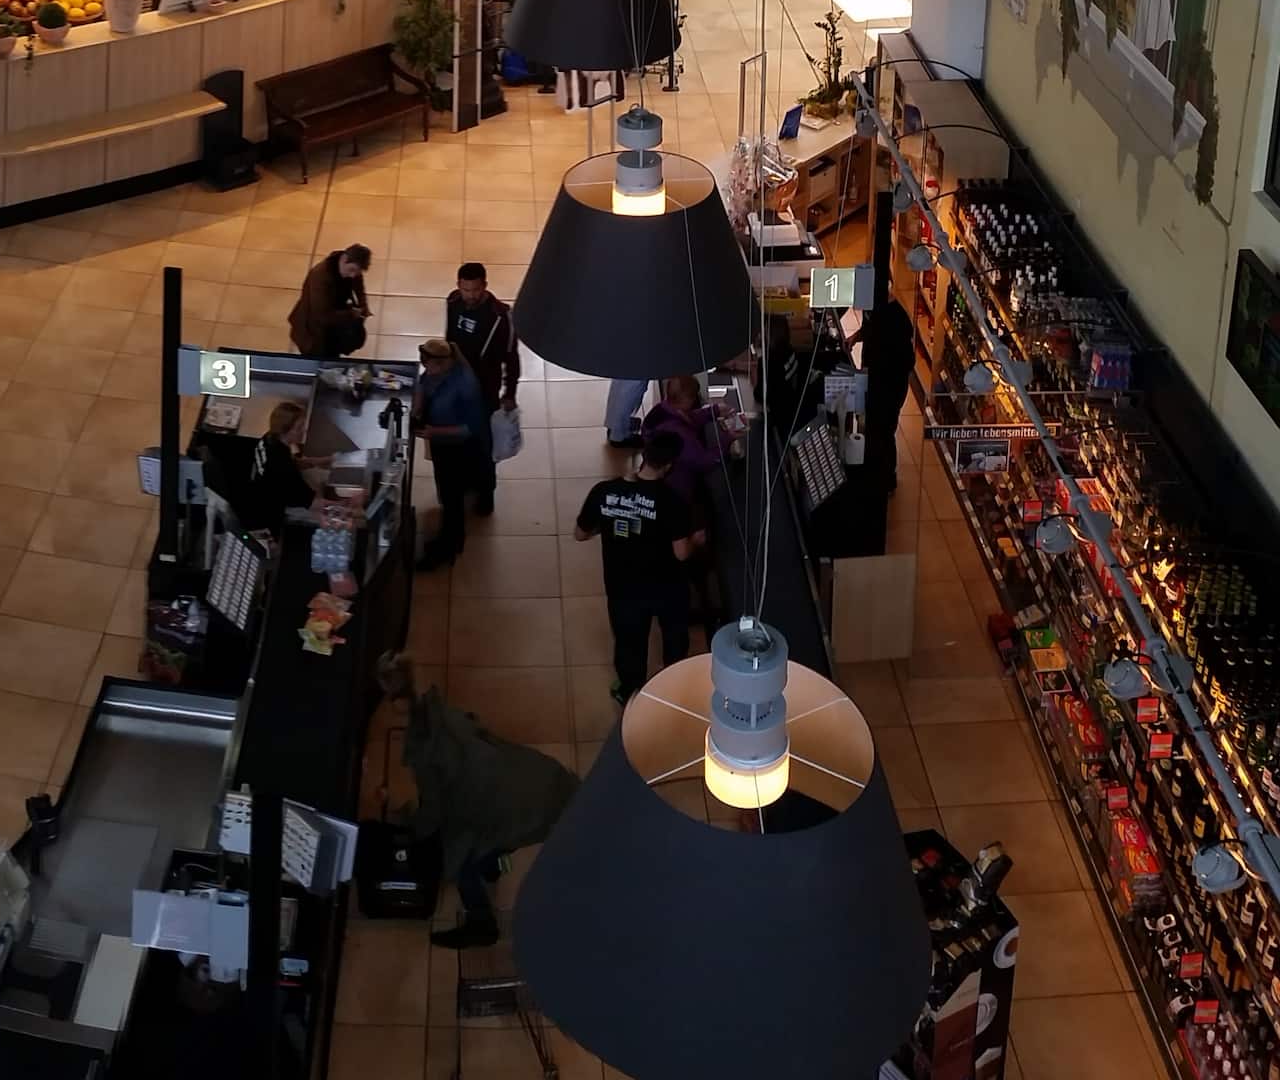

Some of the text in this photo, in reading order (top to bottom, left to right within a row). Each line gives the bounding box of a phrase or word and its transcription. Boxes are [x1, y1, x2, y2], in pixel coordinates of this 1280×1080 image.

[824, 274, 838, 302] 1
[212, 359, 237, 390] 3
[931, 428, 947, 439] Wir
